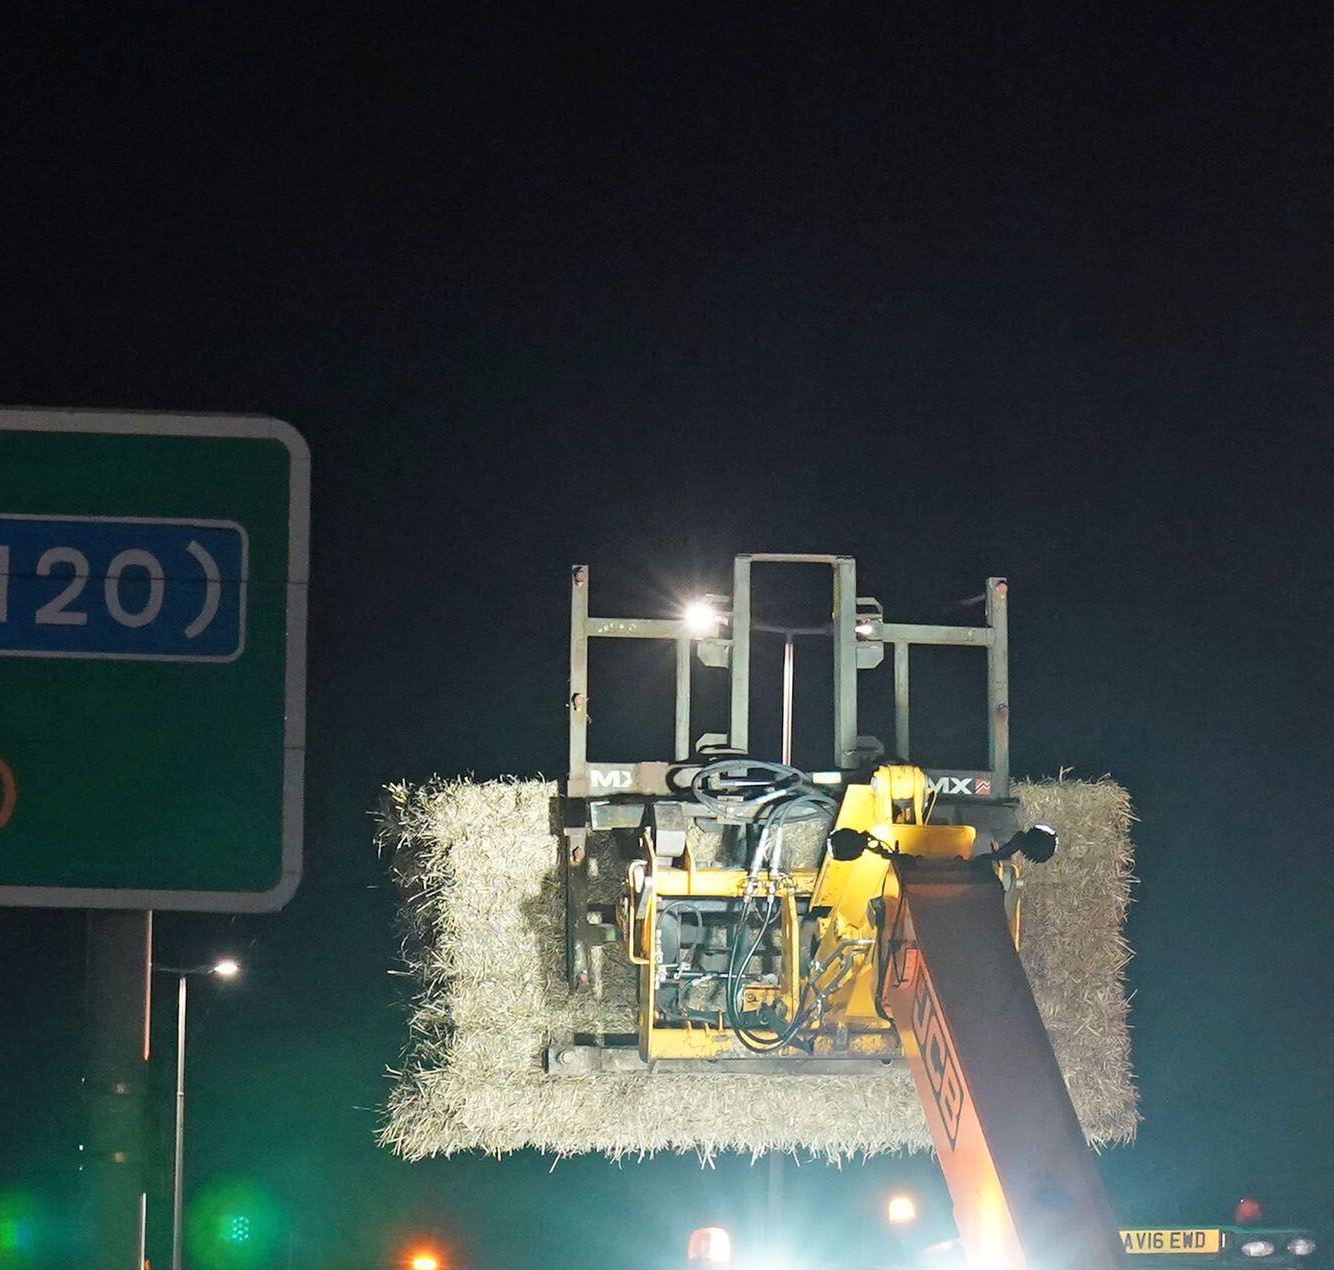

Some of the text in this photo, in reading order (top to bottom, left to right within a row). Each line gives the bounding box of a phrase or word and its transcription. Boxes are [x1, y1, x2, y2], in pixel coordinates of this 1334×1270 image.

[927, 776, 974, 795] MX
[1123, 1230, 1206, 1250] AV16 EWD
